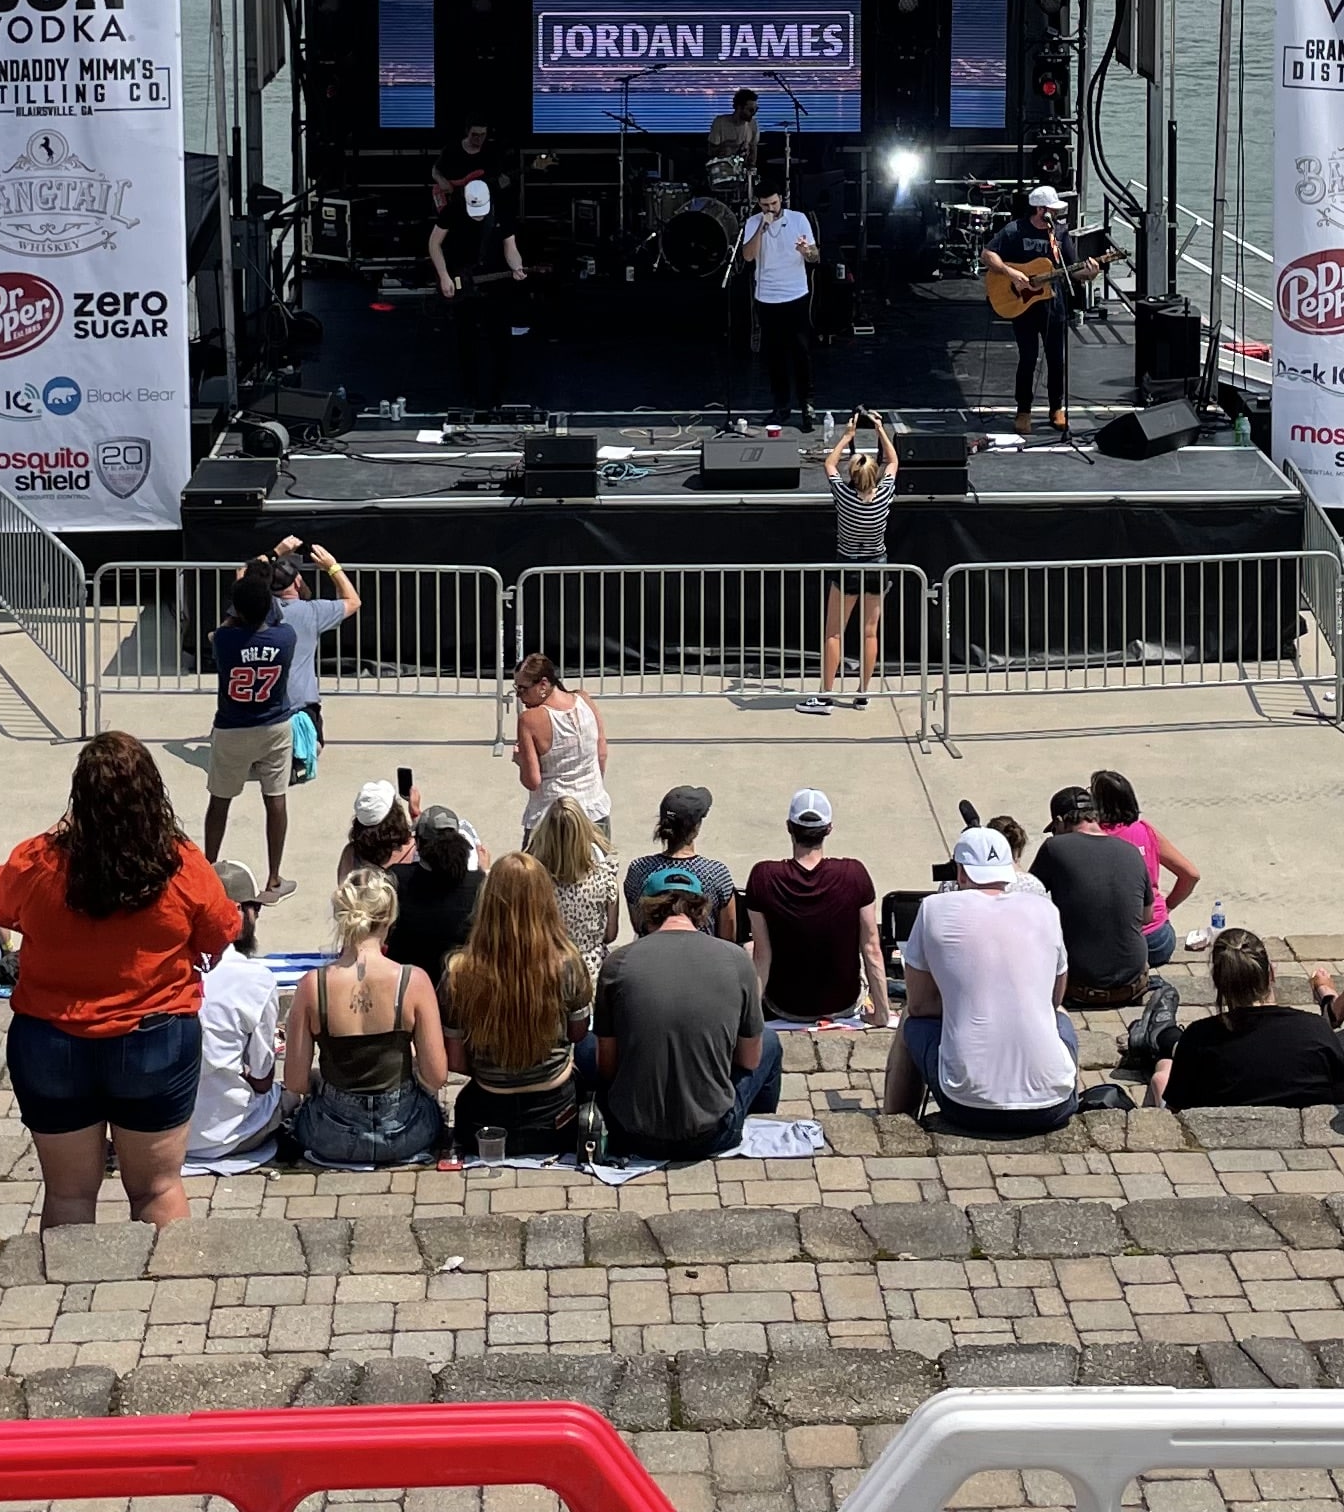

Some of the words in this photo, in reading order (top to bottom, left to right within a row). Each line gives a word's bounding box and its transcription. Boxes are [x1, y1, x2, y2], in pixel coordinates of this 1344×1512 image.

[550, 23, 704, 61] JORDAN
[718, 23, 844, 61] JAMES
[79, 57, 155, 82] MIMM'S
[129, 82, 167, 103] CO.
[80, 106, 94, 116] GA
[17, 239, 81, 253] WHISKEY
[73, 290, 168, 318] zero
[73, 318, 169, 339] SUGAR
[1277, 359, 1326, 385] Dock
[5, 390, 33, 413] IQ
[87, 388, 132, 403] Black
[137, 387, 176, 402] Bear
[102, 445, 143, 465] 20
[15, 470, 91, 491] shield
[240, 646, 281, 663] RILEY
[228, 665, 283, 703] 27
